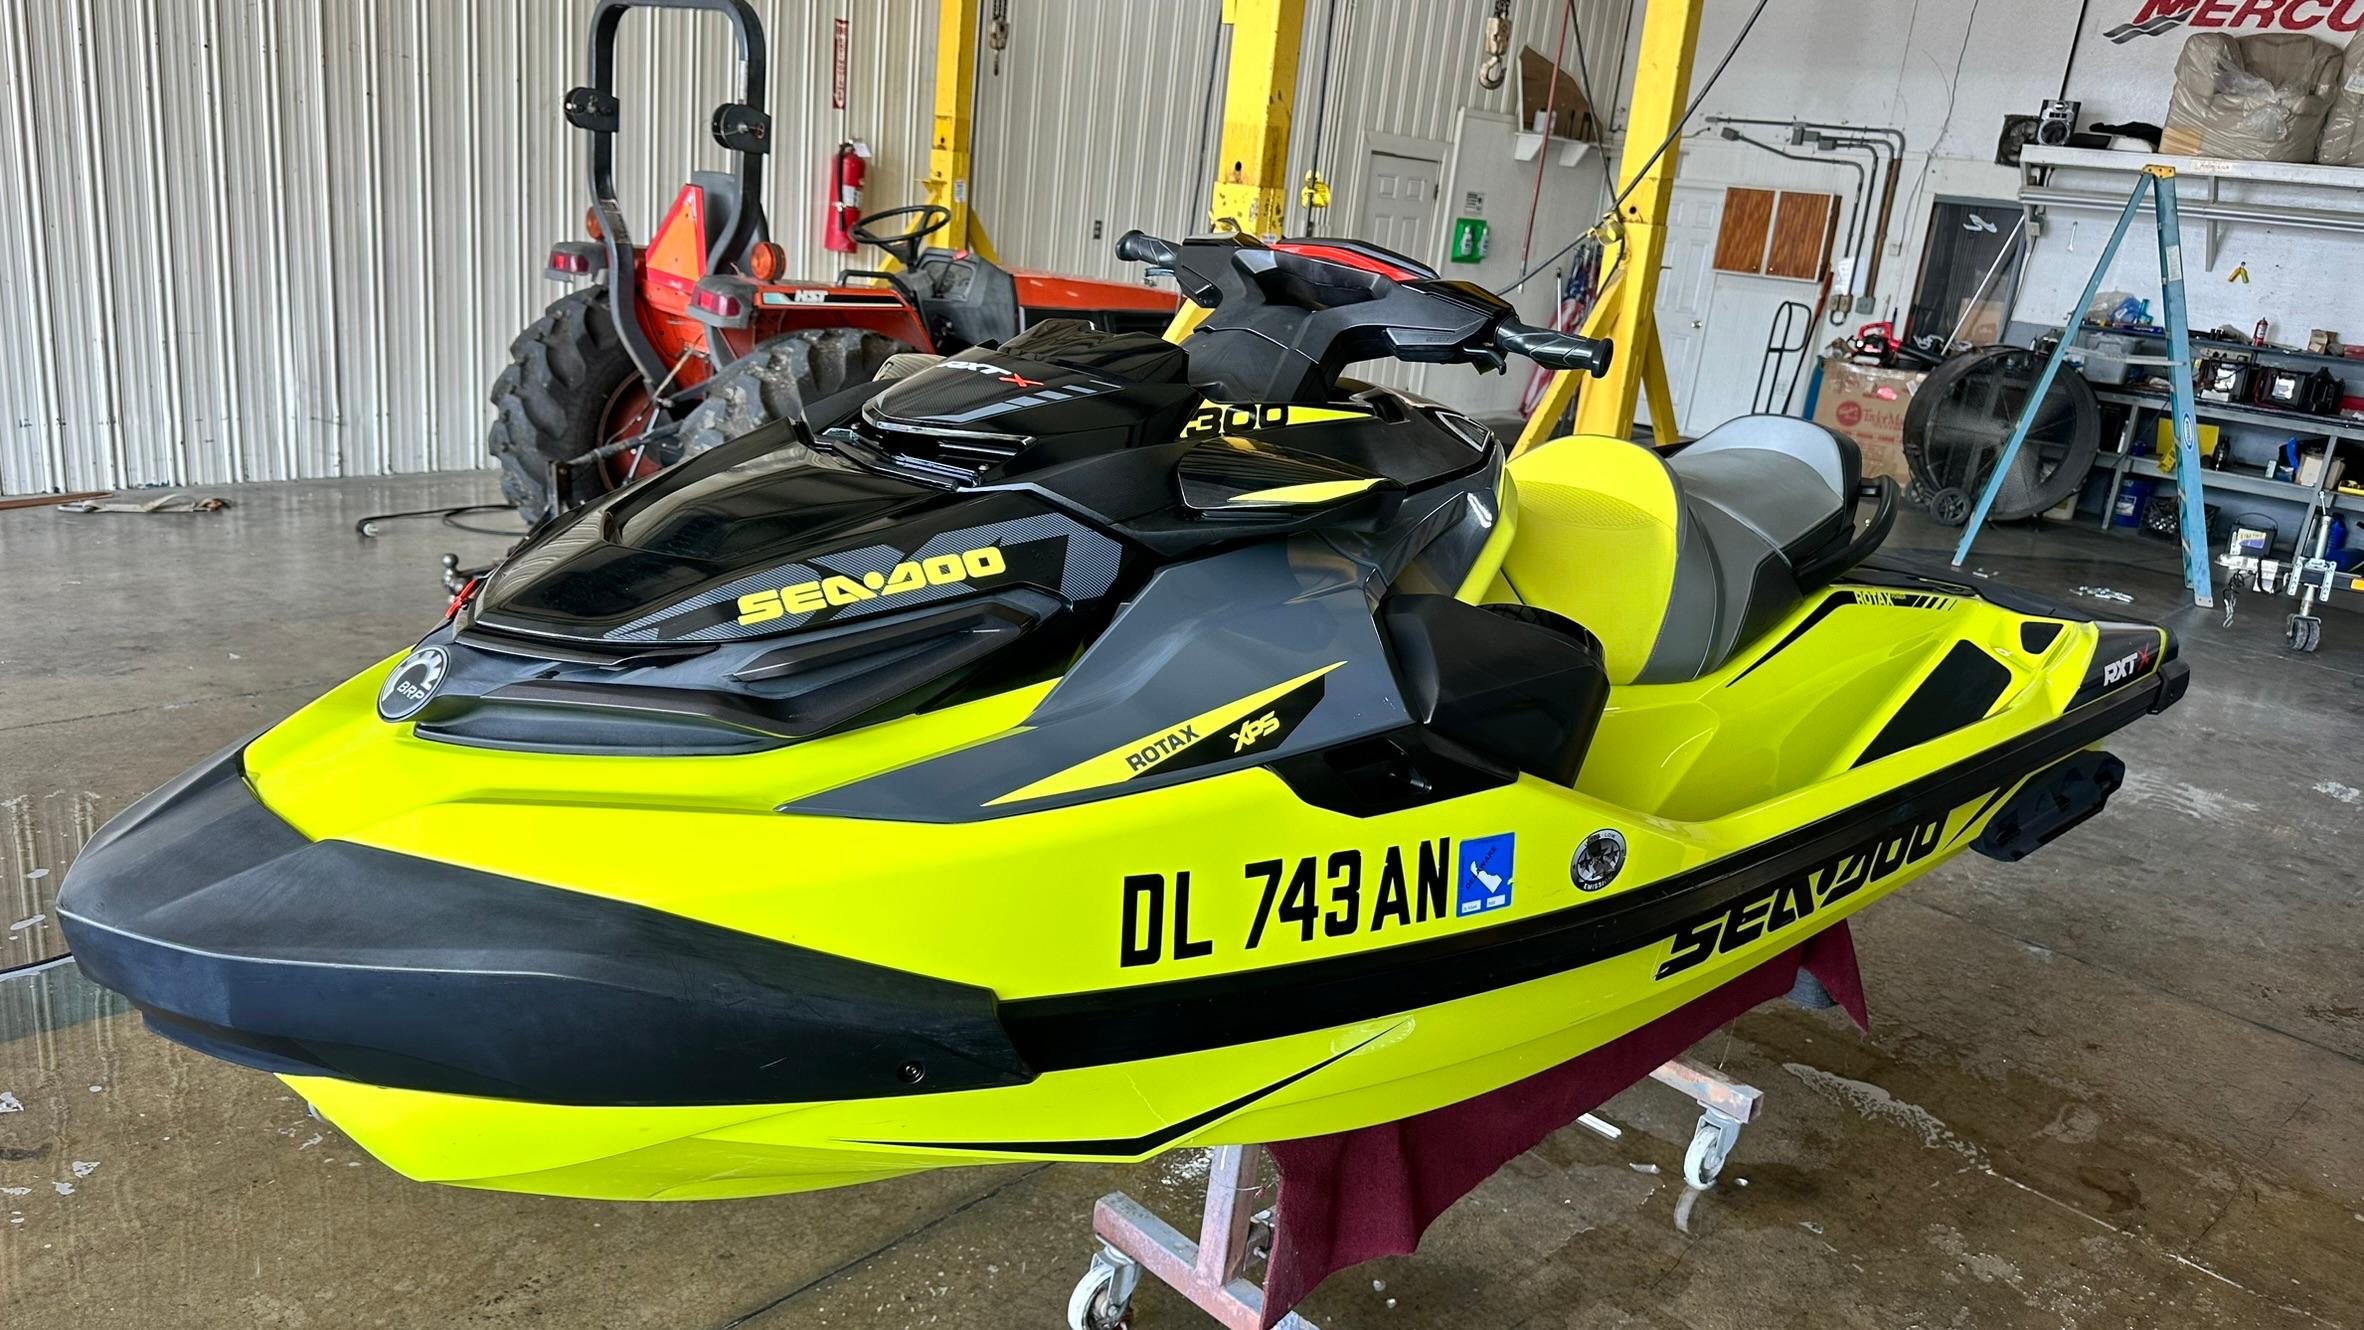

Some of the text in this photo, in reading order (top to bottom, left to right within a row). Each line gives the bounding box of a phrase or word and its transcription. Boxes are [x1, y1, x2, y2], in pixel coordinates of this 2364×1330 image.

[1854, 590, 1895, 607] ROTAX
[396, 680, 425, 700] BRP
[1124, 724, 1200, 772] ROTAX
[1229, 710, 1280, 754] XPS
[1120, 871, 1213, 968] DL
